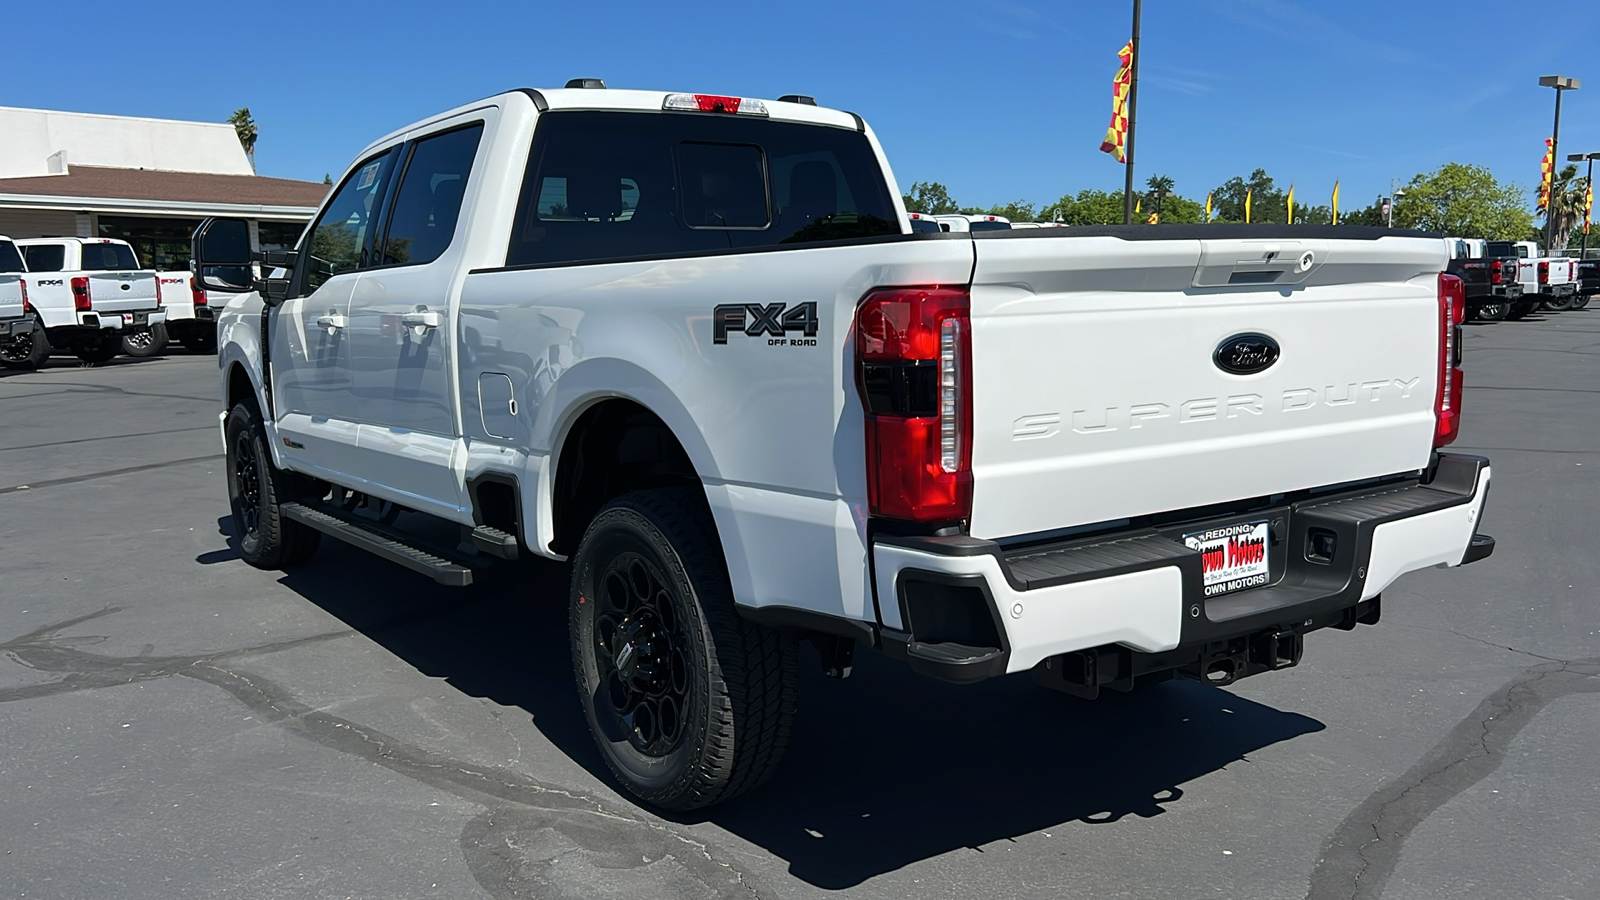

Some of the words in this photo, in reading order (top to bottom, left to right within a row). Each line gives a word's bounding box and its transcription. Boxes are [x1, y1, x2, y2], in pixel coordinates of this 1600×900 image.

[38, 279, 63, 287] FX4
[713, 301, 818, 345] FX4
[1231, 343, 1268, 366] Ford
[1012, 393, 1263, 442] SUPER
[1281, 376, 1420, 413] DUTY
[1205, 524, 1250, 540] REDDING
[1228, 538, 1264, 568] Motors
[1204, 585, 1227, 596] OWN
[1227, 574, 1265, 590] MOTORS
